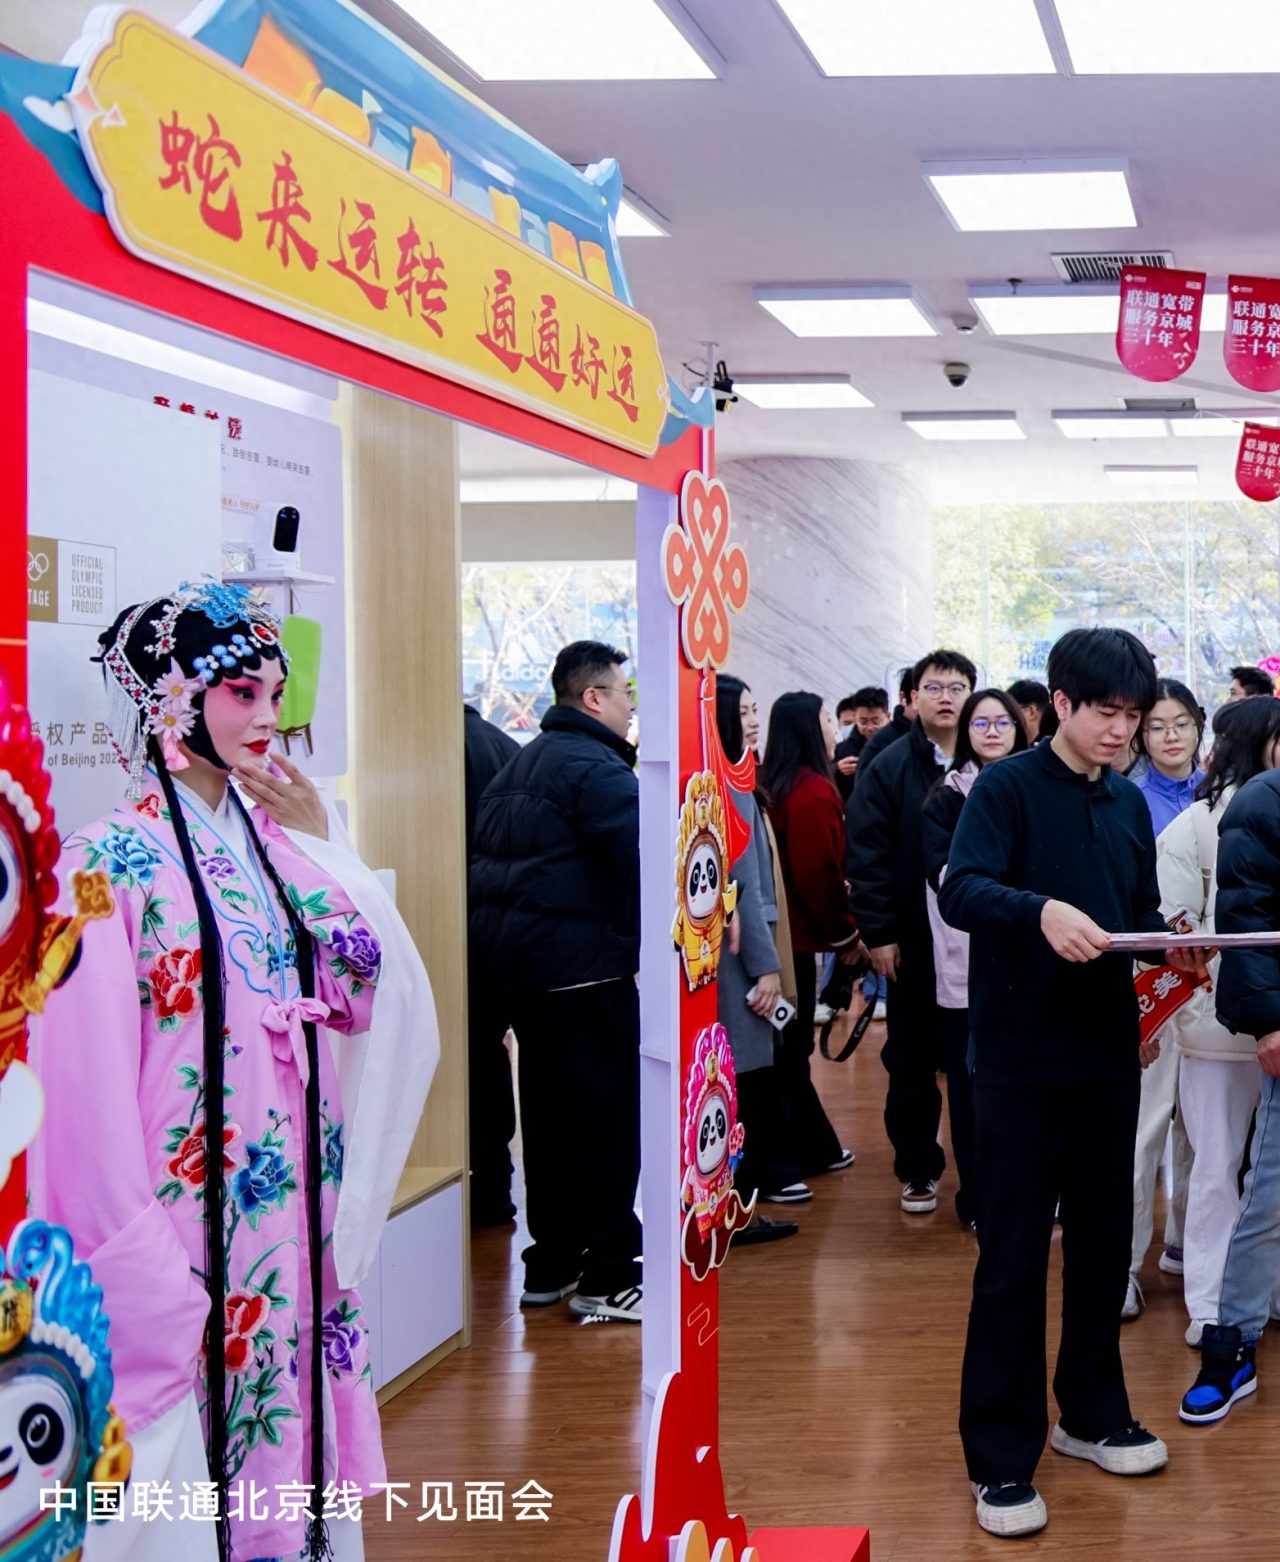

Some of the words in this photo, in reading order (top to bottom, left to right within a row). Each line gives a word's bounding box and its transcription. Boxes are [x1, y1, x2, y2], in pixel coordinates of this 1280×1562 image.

[157, 111, 447, 337] 蛇来运转
[475, 270, 639, 422] 通通好运
[1125, 289, 1195, 312] 联通宽带
[1123, 307, 1193, 331] 服务京城
[1123, 327, 1173, 348] 三十年
[1230, 338, 1280, 357] 三十年
[1240, 464, 1275, 479] 三十年
[71, 553, 103, 571] OFFICIAL
[71, 569, 103, 585] OLYMPIC
[71, 584, 103, 600] LICENSED
[71, 599, 103, 615] PRODUCT
[48, 754, 58, 766] of
[61, 753, 96, 768] Beijing
